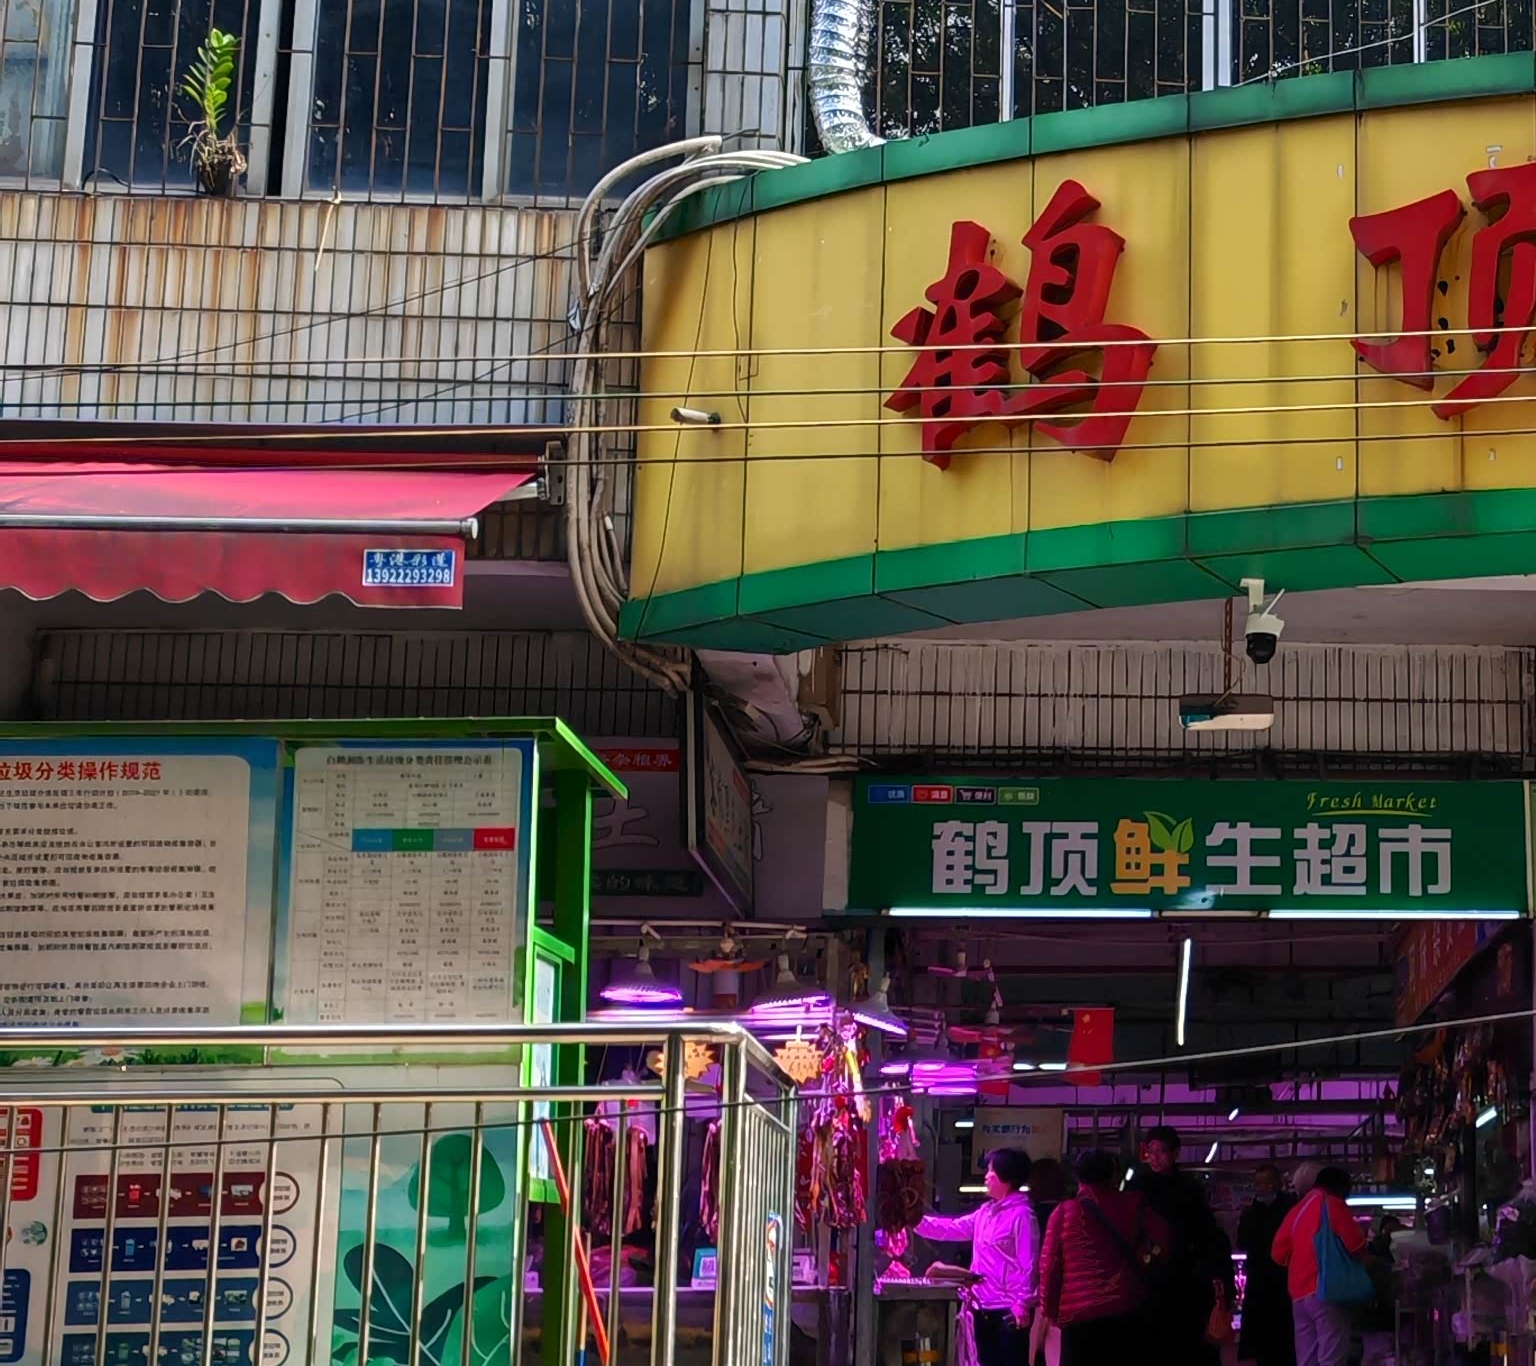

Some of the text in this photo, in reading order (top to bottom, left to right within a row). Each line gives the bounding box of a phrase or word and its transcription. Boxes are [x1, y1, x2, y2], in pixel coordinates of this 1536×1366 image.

[367, 568, 450, 583] 13922293298
[1307, 791, 1438, 811] Fresh Market
[931, 818, 1452, 896] 鹤顶鲜生超市
